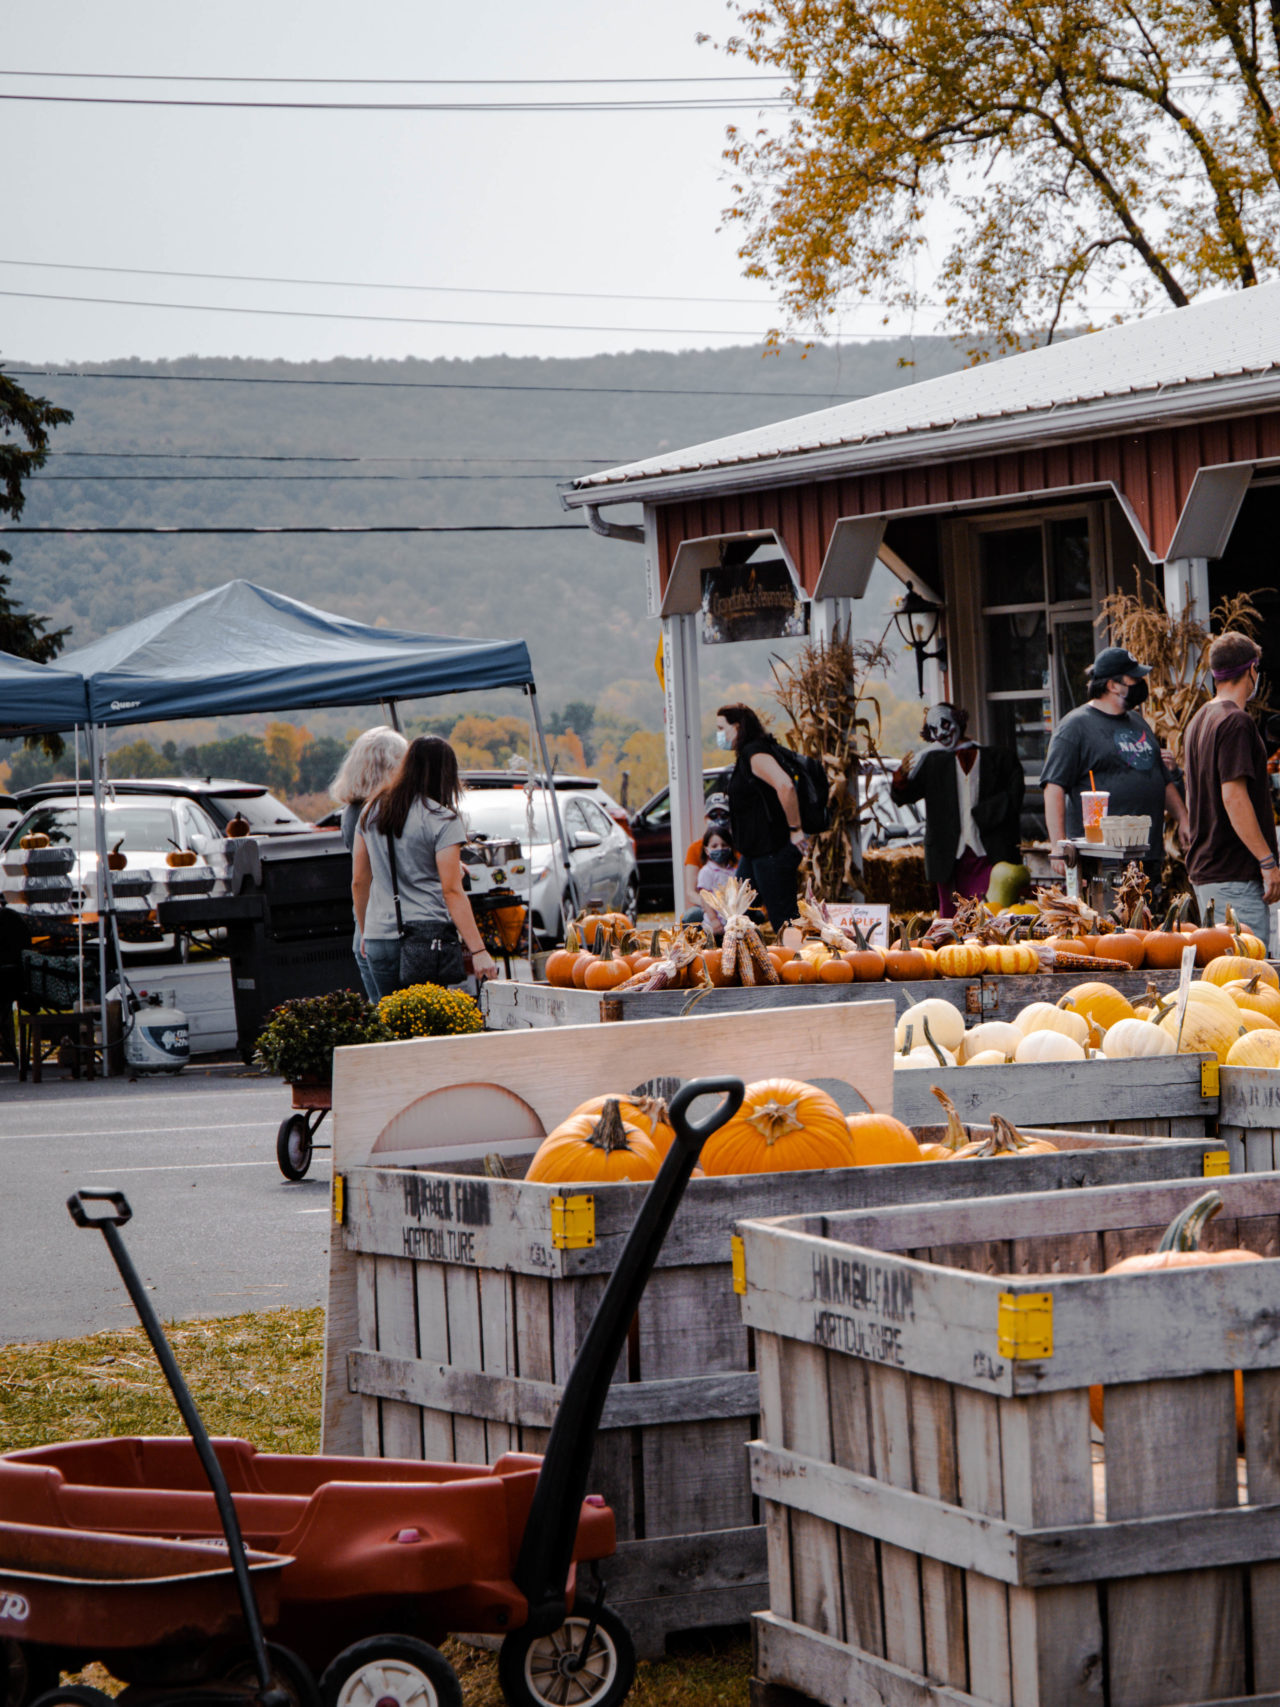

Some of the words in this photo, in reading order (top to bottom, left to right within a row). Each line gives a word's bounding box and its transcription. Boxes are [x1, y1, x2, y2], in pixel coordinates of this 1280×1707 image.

[1119, 741, 1152, 753] NASA
[402, 1226, 476, 1263] HORTICULTURE
[814, 1309, 905, 1366] HORTICULTURE
